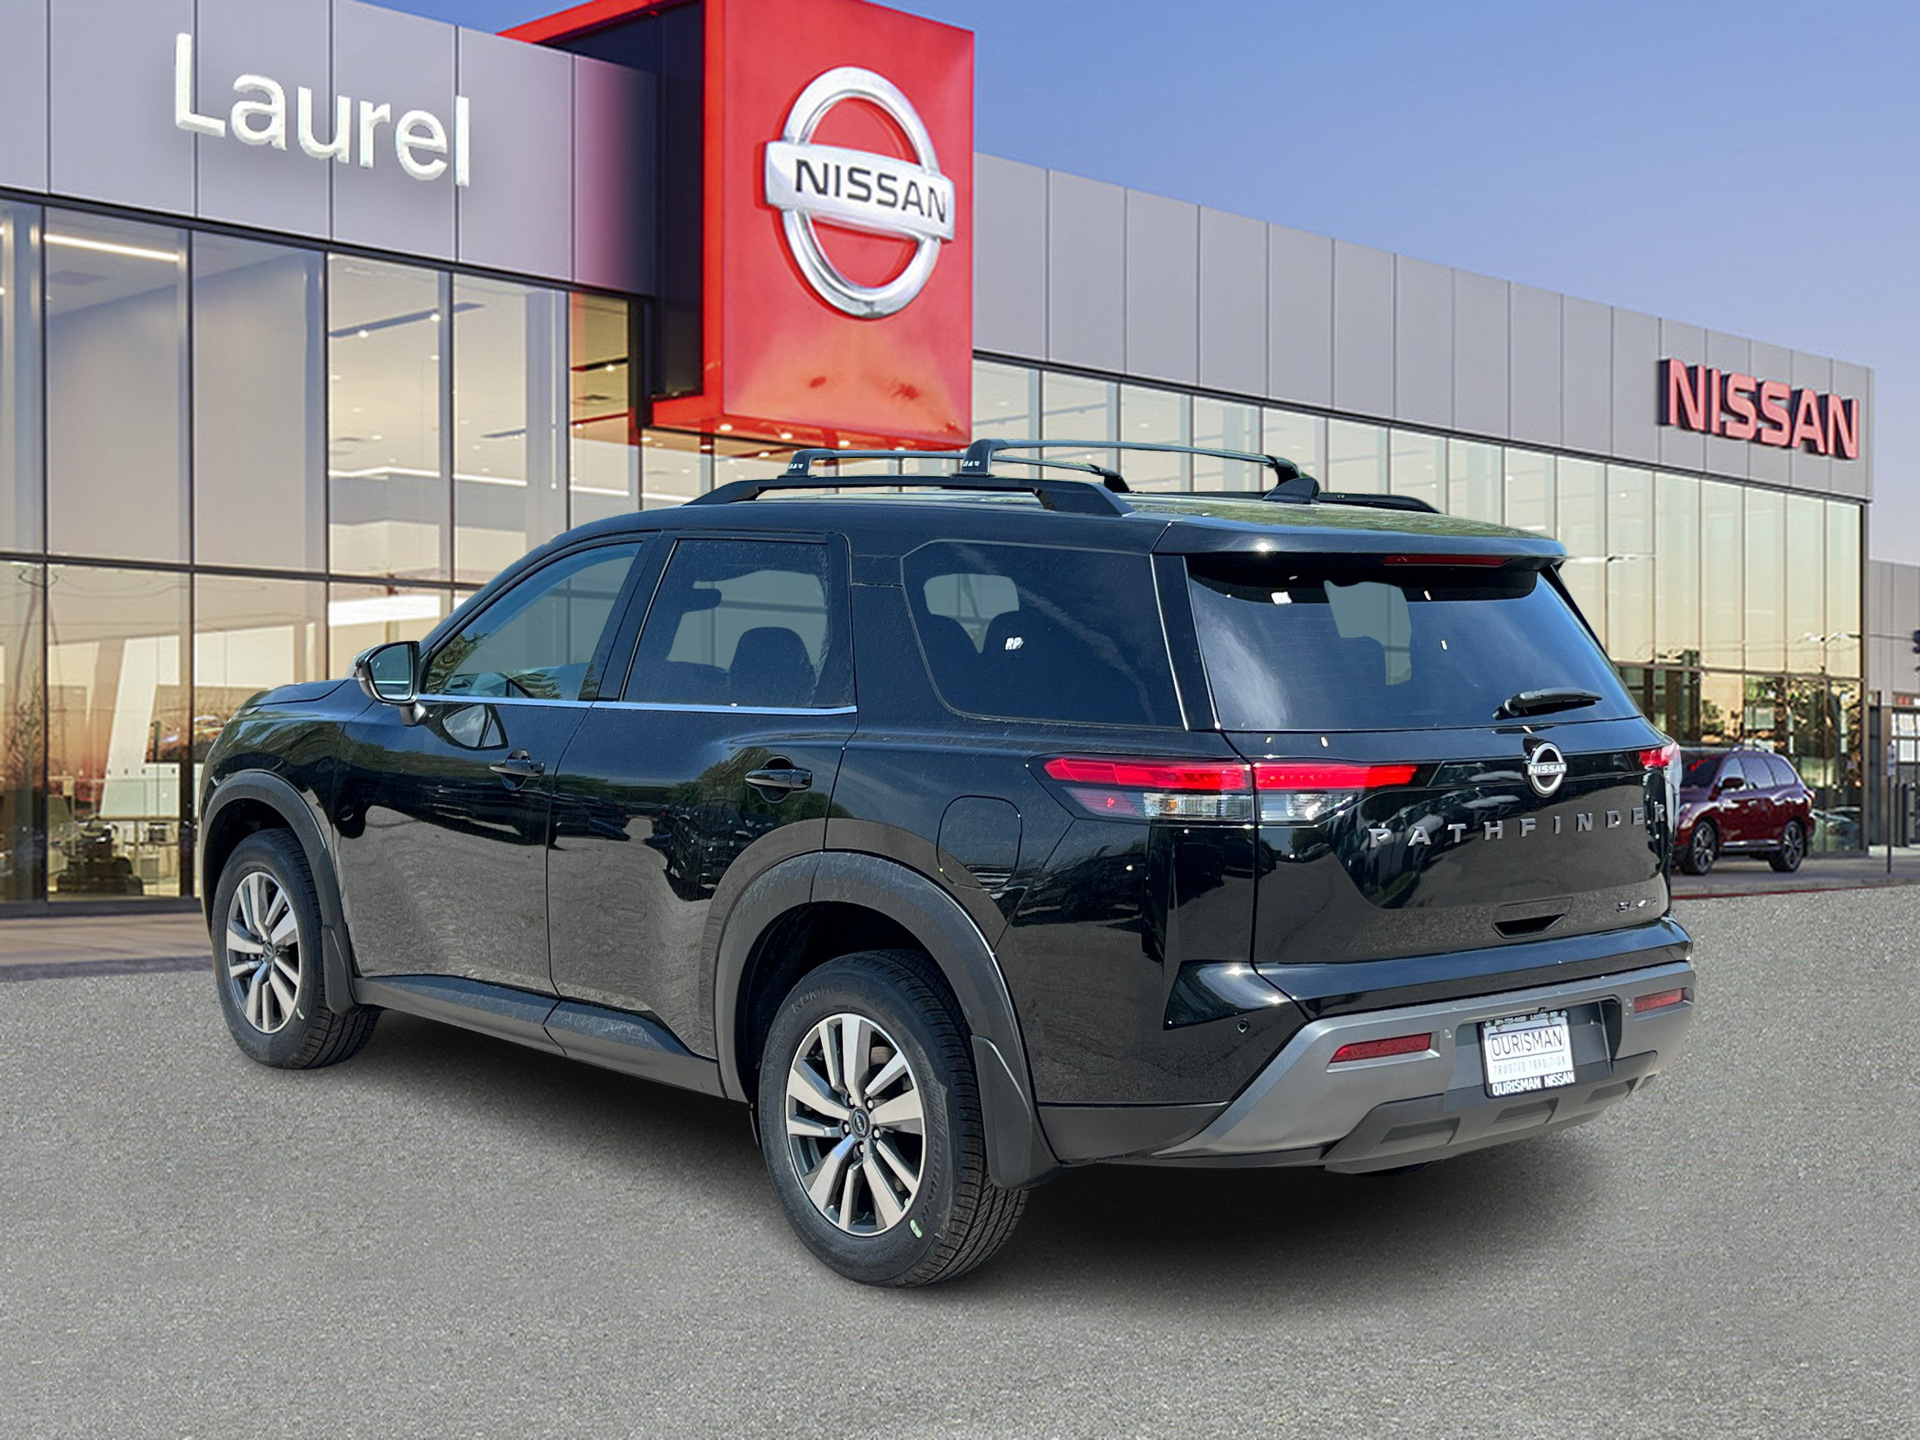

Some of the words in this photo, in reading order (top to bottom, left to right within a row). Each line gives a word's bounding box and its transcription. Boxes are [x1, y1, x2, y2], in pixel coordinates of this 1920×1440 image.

[175, 33, 470, 187] Laurel
[796, 158, 946, 223] NISSAN
[1660, 358, 1860, 459] NISSAN
[1528, 764, 1567, 775] NISSAN
[1369, 804, 1666, 848] PATHFINDER
[1491, 1029, 1563, 1056] OURISMAN
[1492, 1076, 1542, 1096] OURISMAN
[1543, 1070, 1575, 1088] NISSAN
